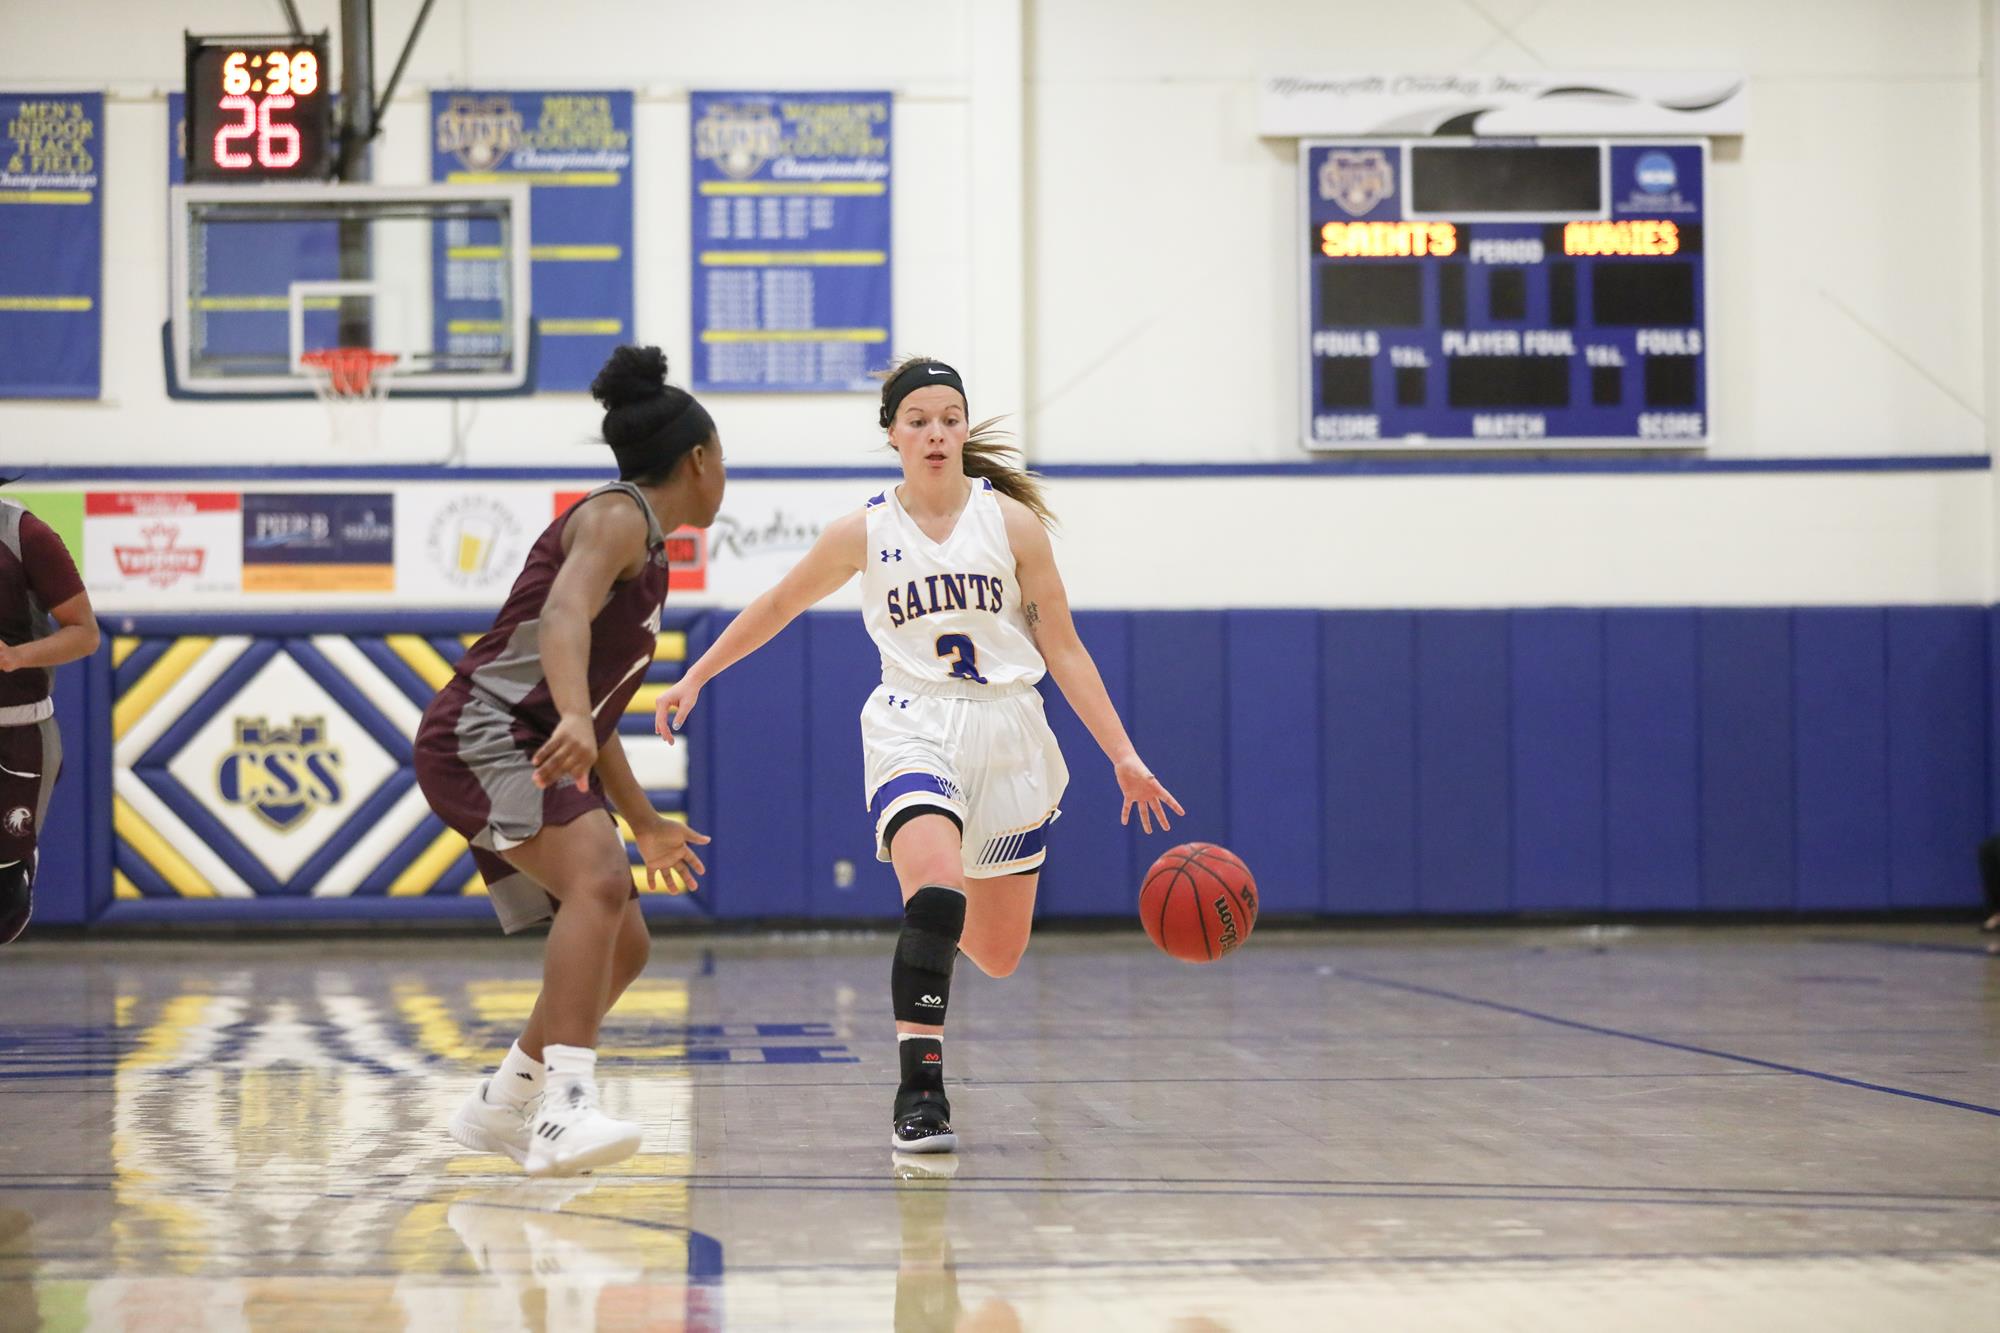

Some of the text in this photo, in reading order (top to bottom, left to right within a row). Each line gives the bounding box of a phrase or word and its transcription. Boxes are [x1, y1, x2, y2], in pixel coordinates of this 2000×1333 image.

[224, 51, 317, 95] 6:38
[20, 102, 83, 120] MEN'S
[8, 120, 93, 139] INDOOR
[214, 94, 300, 168] 26
[17, 139, 82, 155] TRACK
[31, 155, 93, 174] FIELD
[0, 172, 98, 190] hampionships
[1321, 221, 1457, 257] SAINTS
[1469, 239, 1544, 264] PERIOD
[1313, 331, 1380, 357] FOULS
[1442, 330, 1577, 356] PLAYER FOUL
[1636, 329, 1701, 355] FOULS
[1314, 415, 1380, 439] SCORE
[1473, 414, 1546, 438] MATCH
[1638, 413, 1702, 438] SCORE
[887, 573, 1004, 629] SAINTS
[213, 749, 346, 808] CSS
